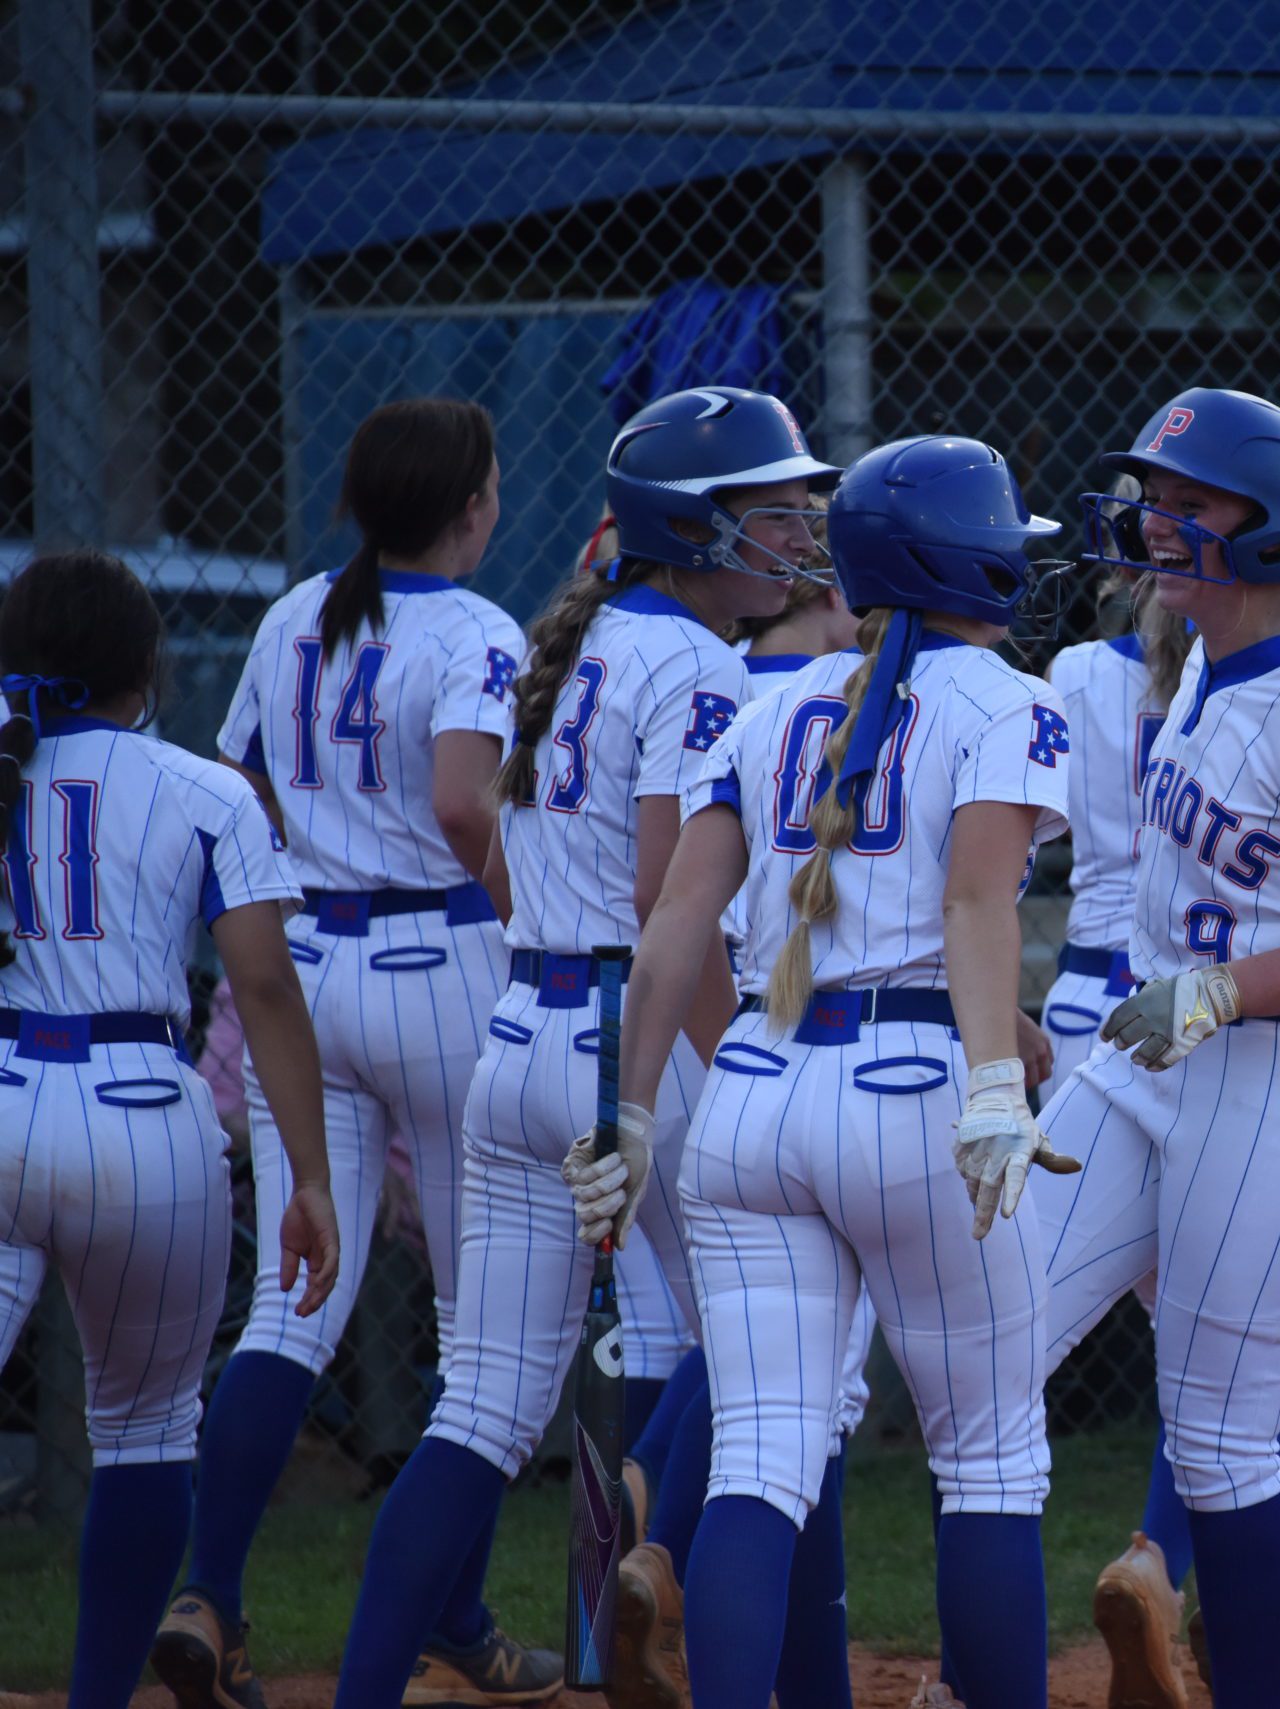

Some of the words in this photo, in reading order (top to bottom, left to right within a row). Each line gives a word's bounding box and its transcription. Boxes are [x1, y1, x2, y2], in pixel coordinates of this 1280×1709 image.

[1146, 407, 1195, 452] P
[291, 636, 391, 792] 14
[514, 656, 607, 815] 3
[683, 691, 738, 752] P
[1028, 703, 1070, 768] P
[772, 694, 920, 856] 00
[0, 780, 105, 940] 11
[1184, 899, 1238, 964] 9
[485, 1647, 522, 1685] N
